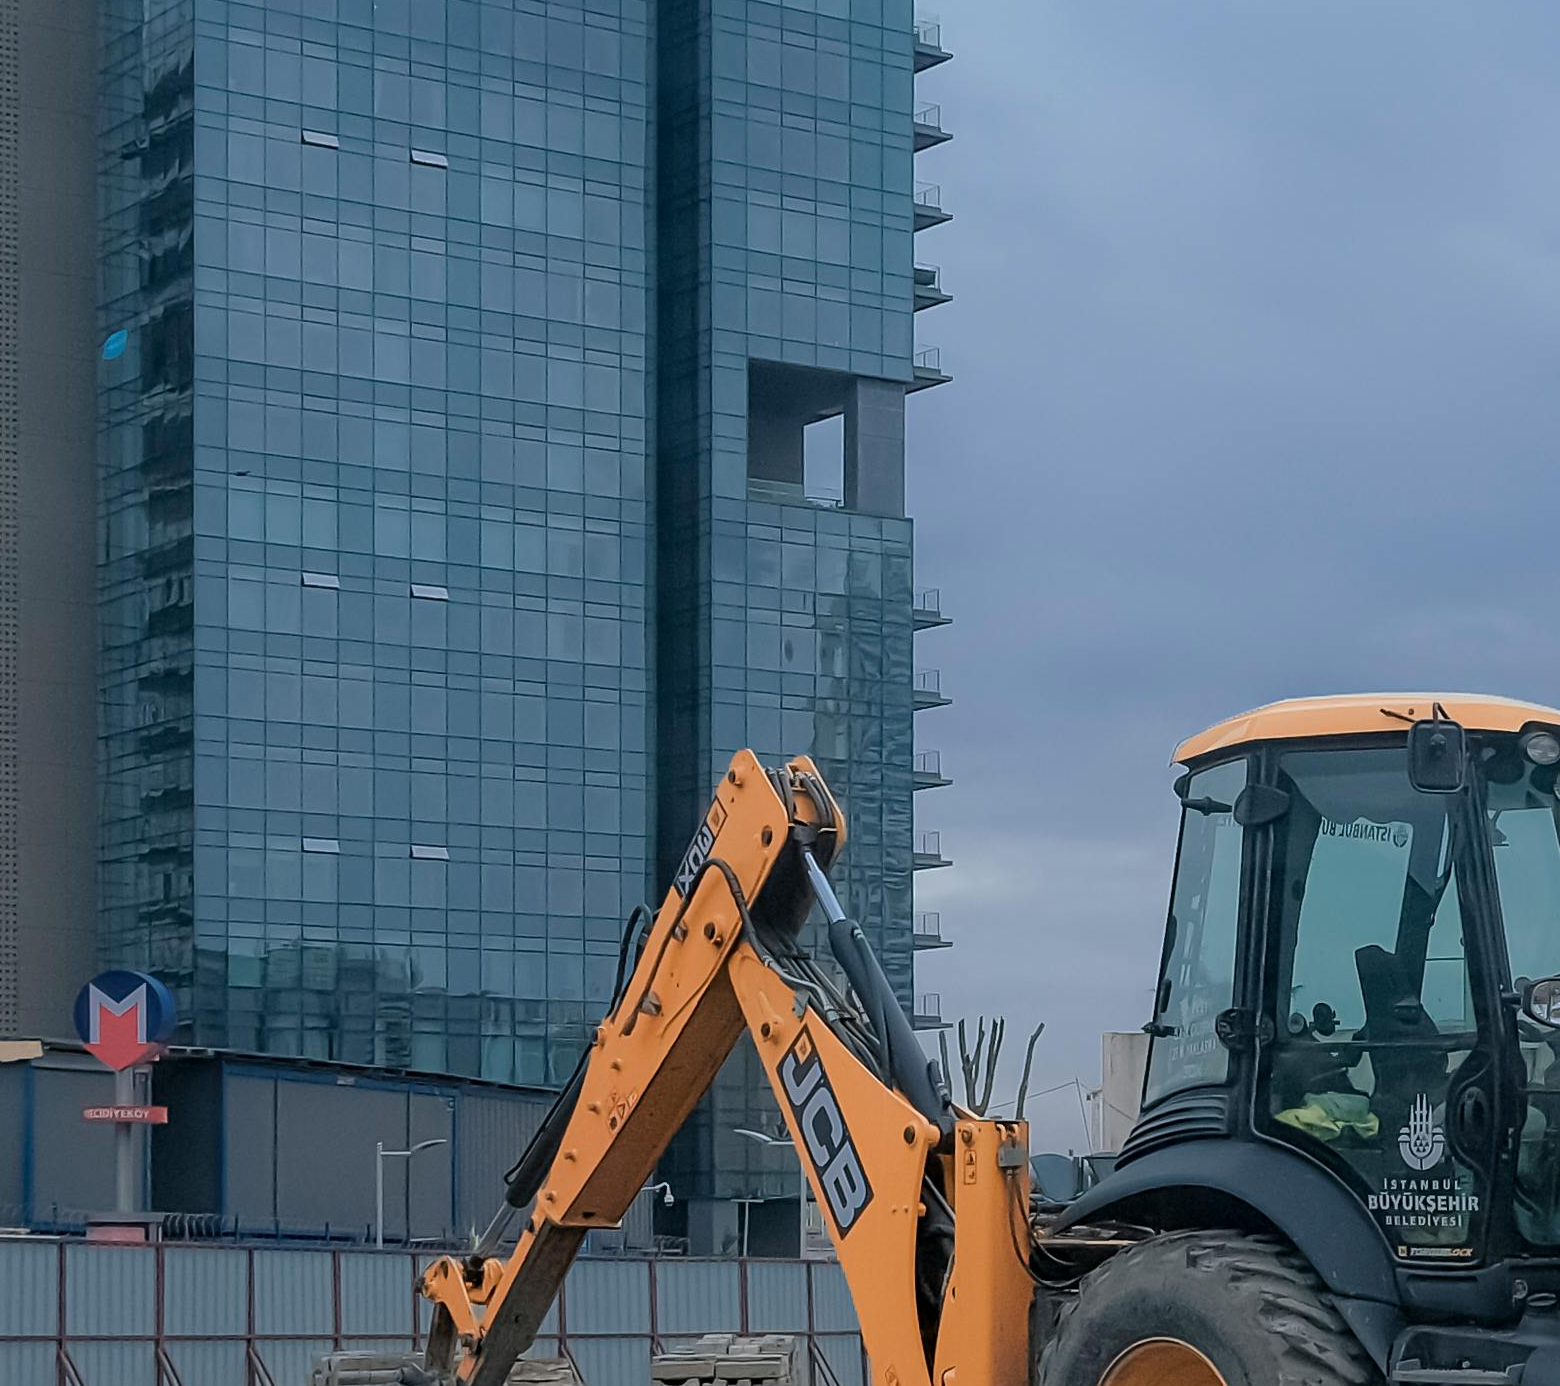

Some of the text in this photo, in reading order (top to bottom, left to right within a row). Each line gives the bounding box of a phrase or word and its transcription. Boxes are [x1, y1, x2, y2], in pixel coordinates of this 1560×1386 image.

[88, 981, 147, 1045] M
[782, 1052, 867, 1228] JCB
[1367, 1191, 1480, 1213] BÜYÜKŞEHİR
[1385, 1213, 1462, 1227] BELEDİYESİ
